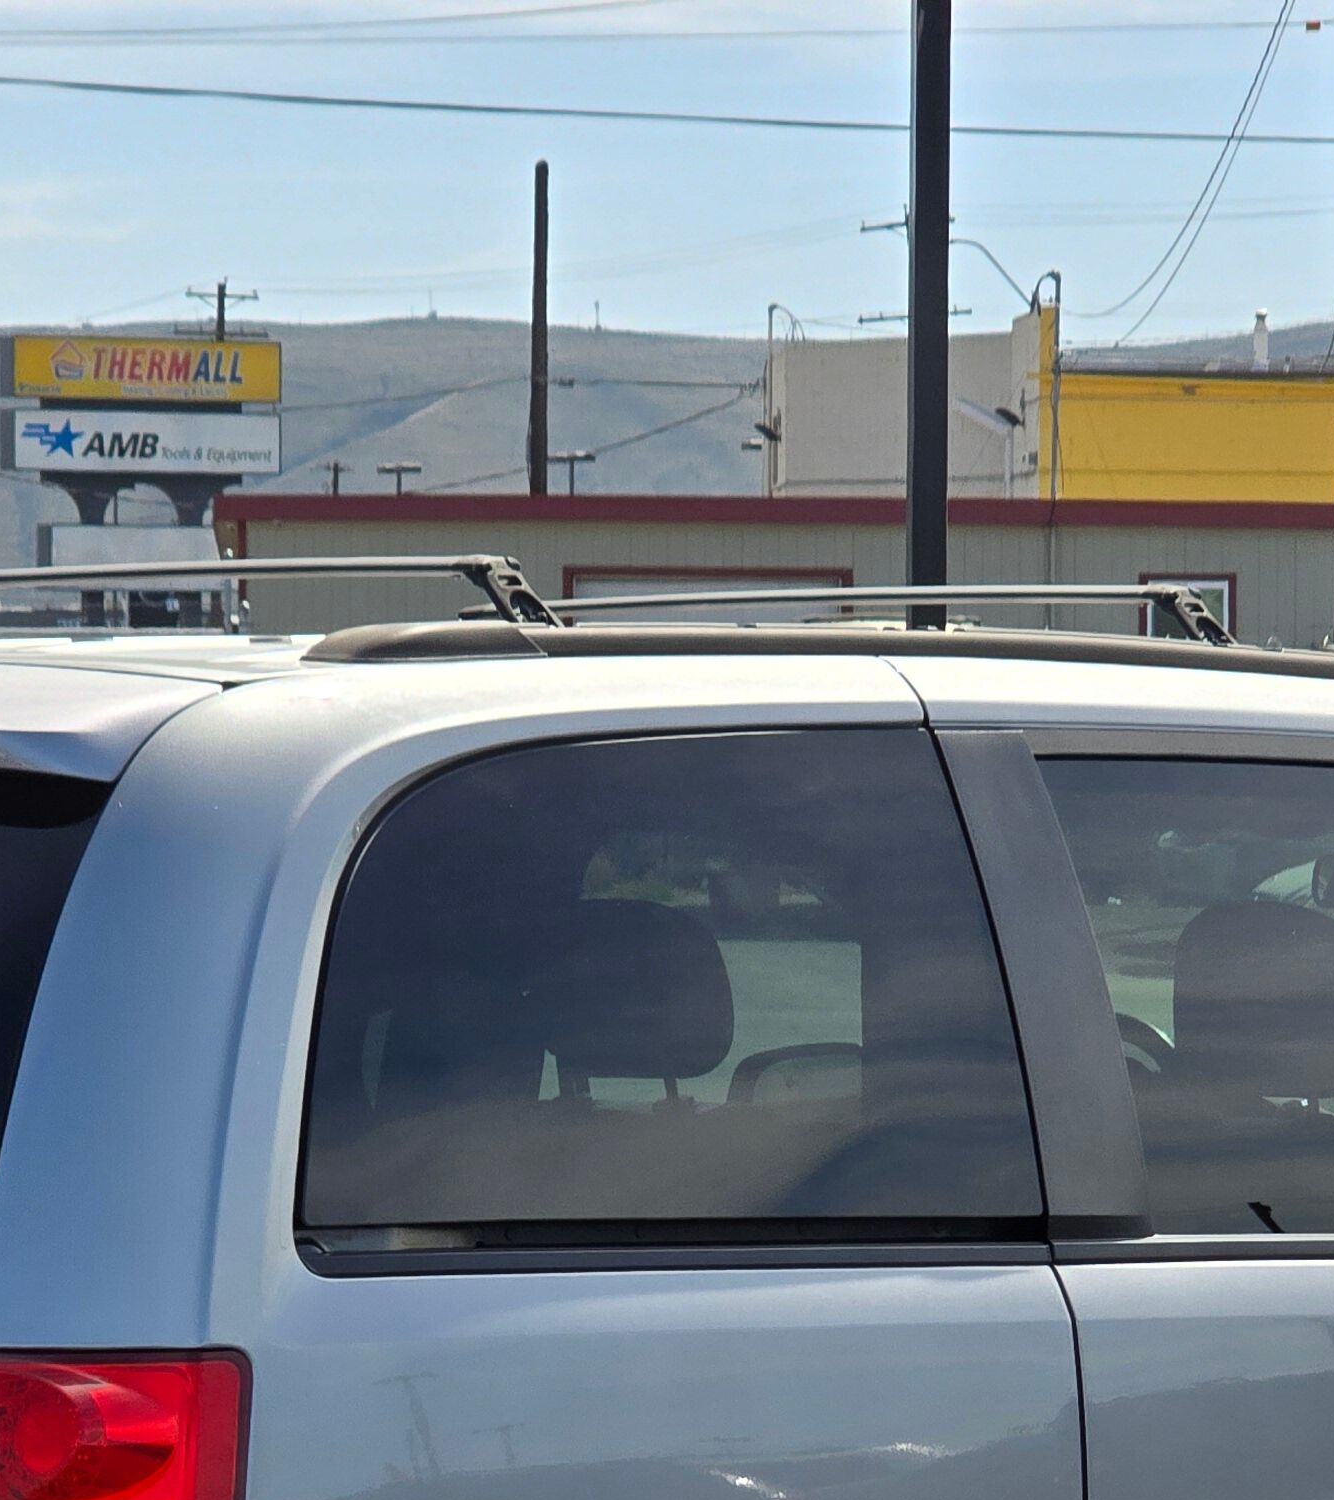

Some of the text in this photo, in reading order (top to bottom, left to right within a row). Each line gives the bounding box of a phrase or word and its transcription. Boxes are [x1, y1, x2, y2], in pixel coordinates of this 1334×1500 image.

[91, 347, 243, 385] THERMALL
[81, 431, 160, 459] AMB
[207, 447, 272, 465] Equipment
